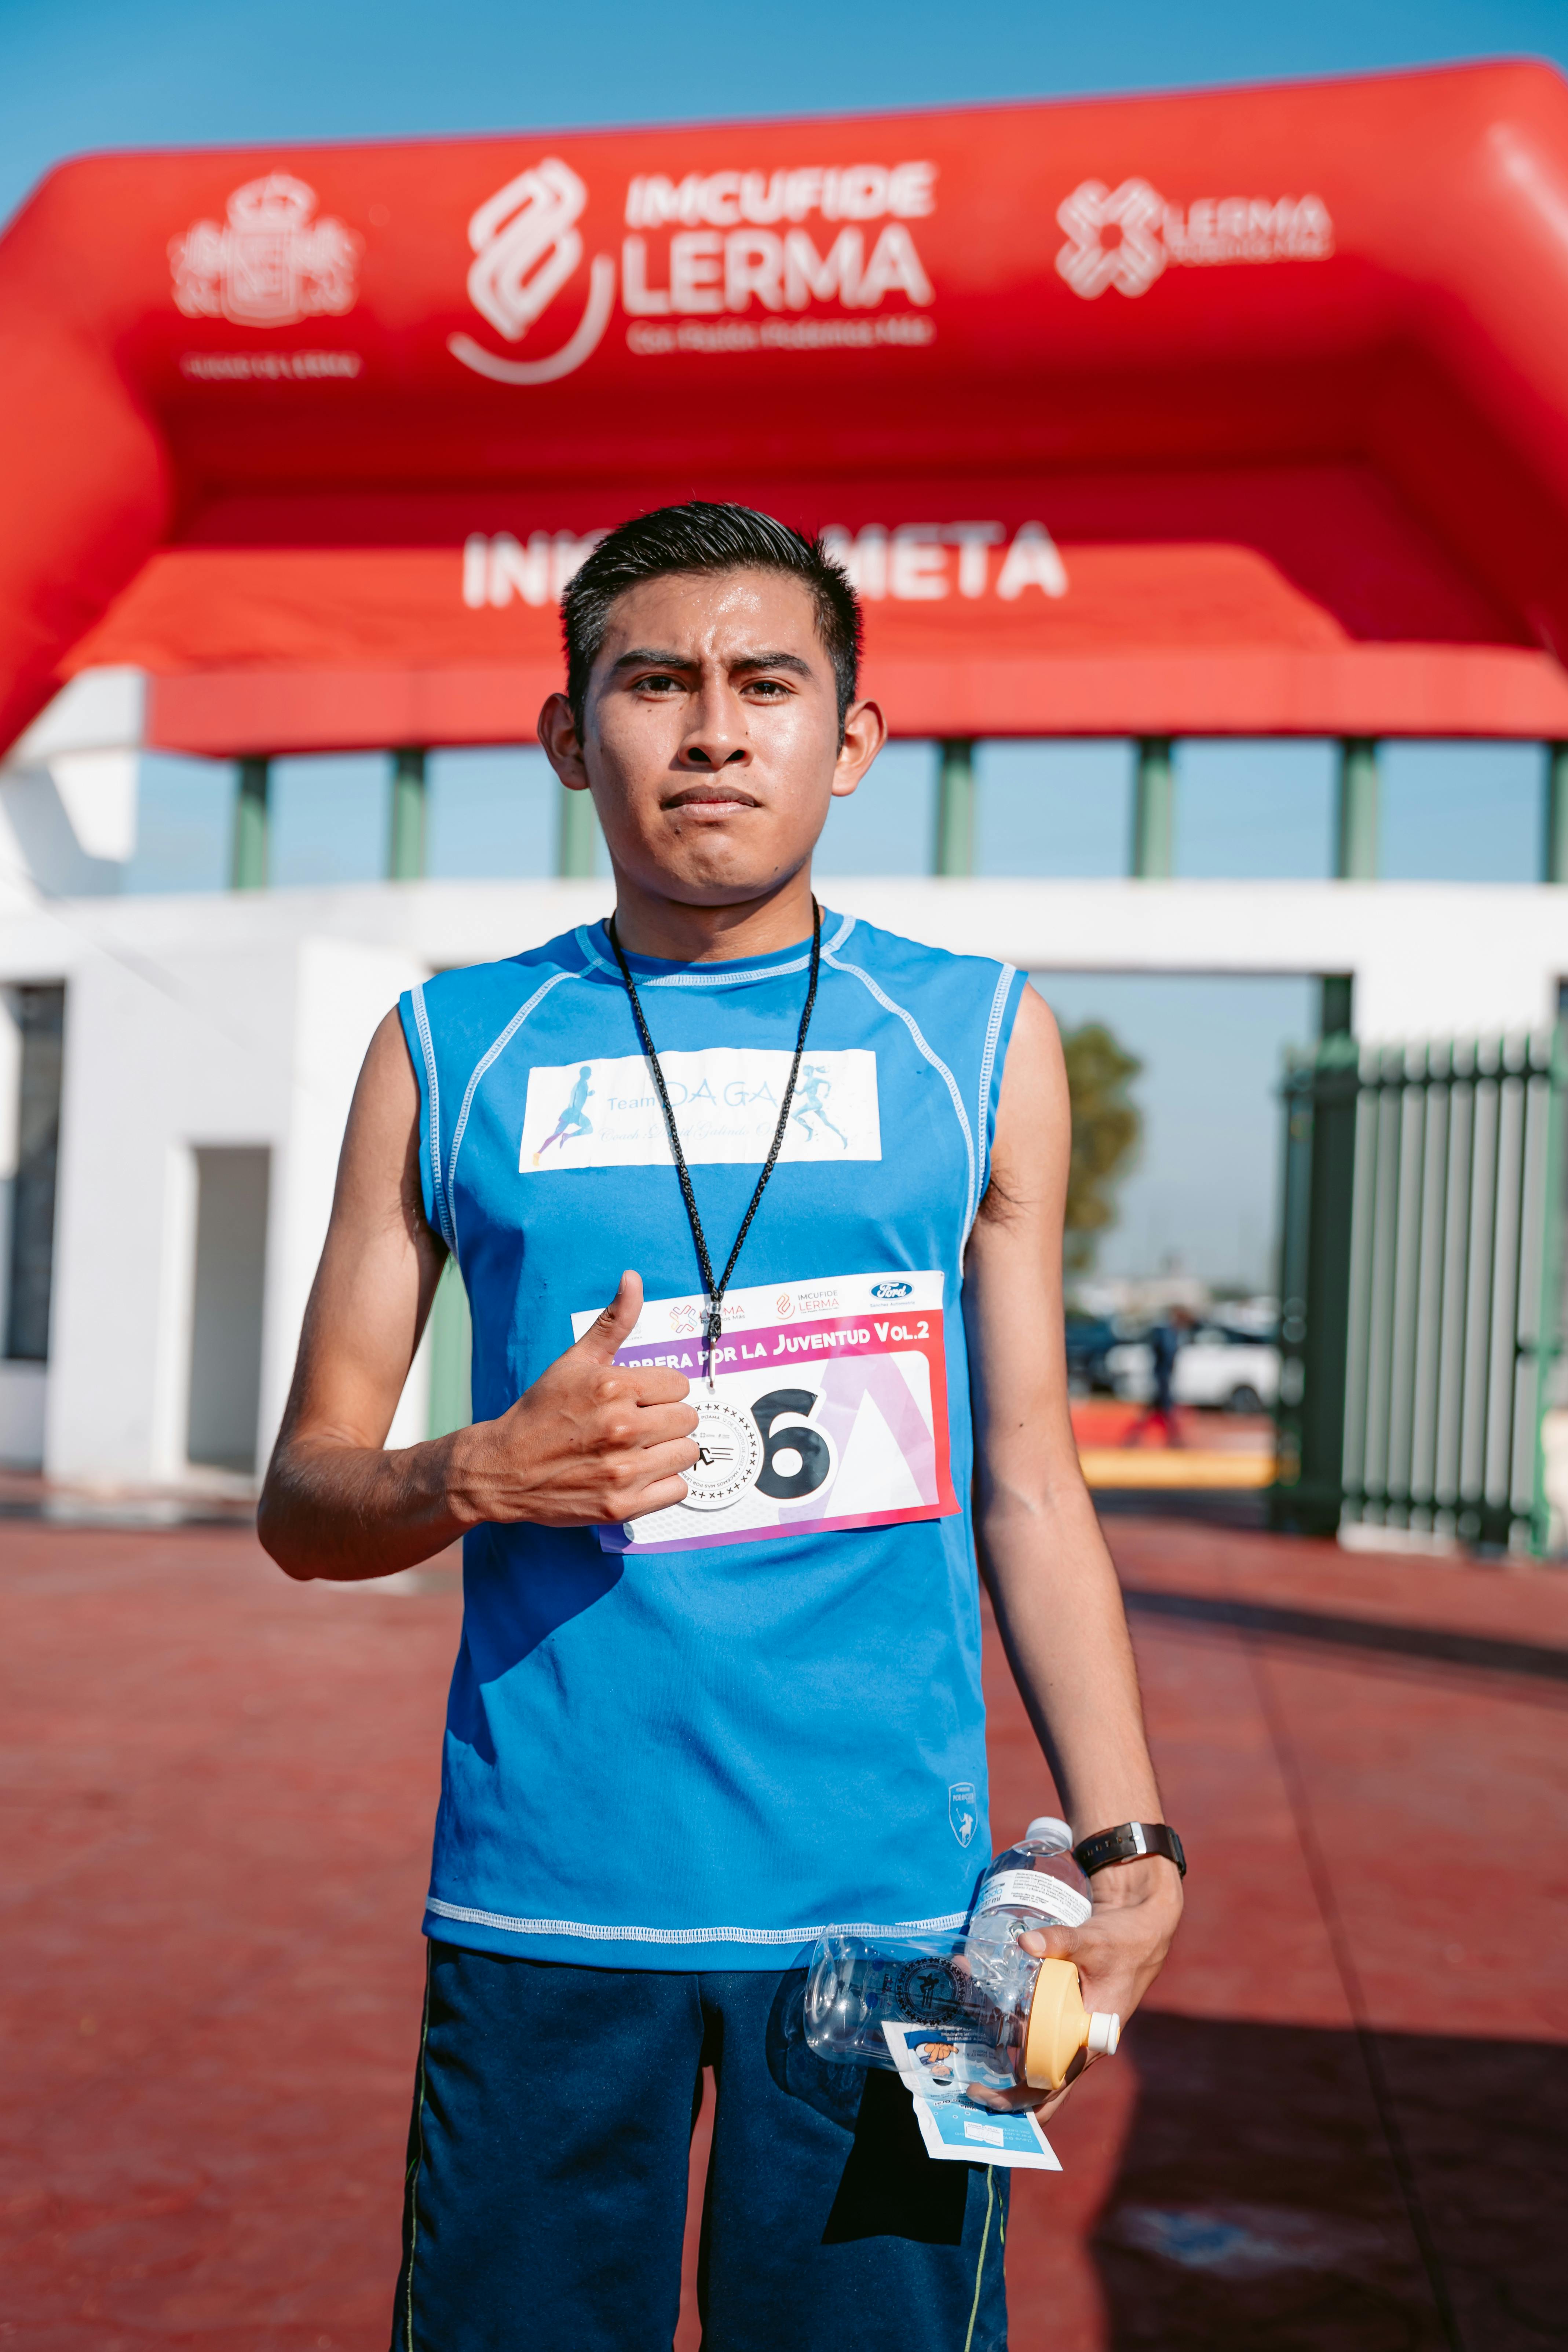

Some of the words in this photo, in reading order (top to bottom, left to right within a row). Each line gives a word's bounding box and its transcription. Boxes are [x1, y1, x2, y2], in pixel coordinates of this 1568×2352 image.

[625, 161, 937, 229] IMCUFIDE
[622, 222, 936, 316] LERMA
[463, 527, 618, 610] INI
[817, 520, 1070, 601] META
[608, 1097, 655, 1111] Team
[798, 1290, 838, 1301] IMCUFIDE
[877, 1283, 907, 1298] Ford
[799, 1298, 840, 1311] LERMA
[612, 1353, 693, 1369] RRERA
[697, 1347, 738, 1366] POR
[741, 1343, 767, 1360] LA
[734, 1427, 745, 1445] AGOSTO
[680, 1472, 692, 1483] LERM
[717, 1471, 739, 1486] HACEMOS
